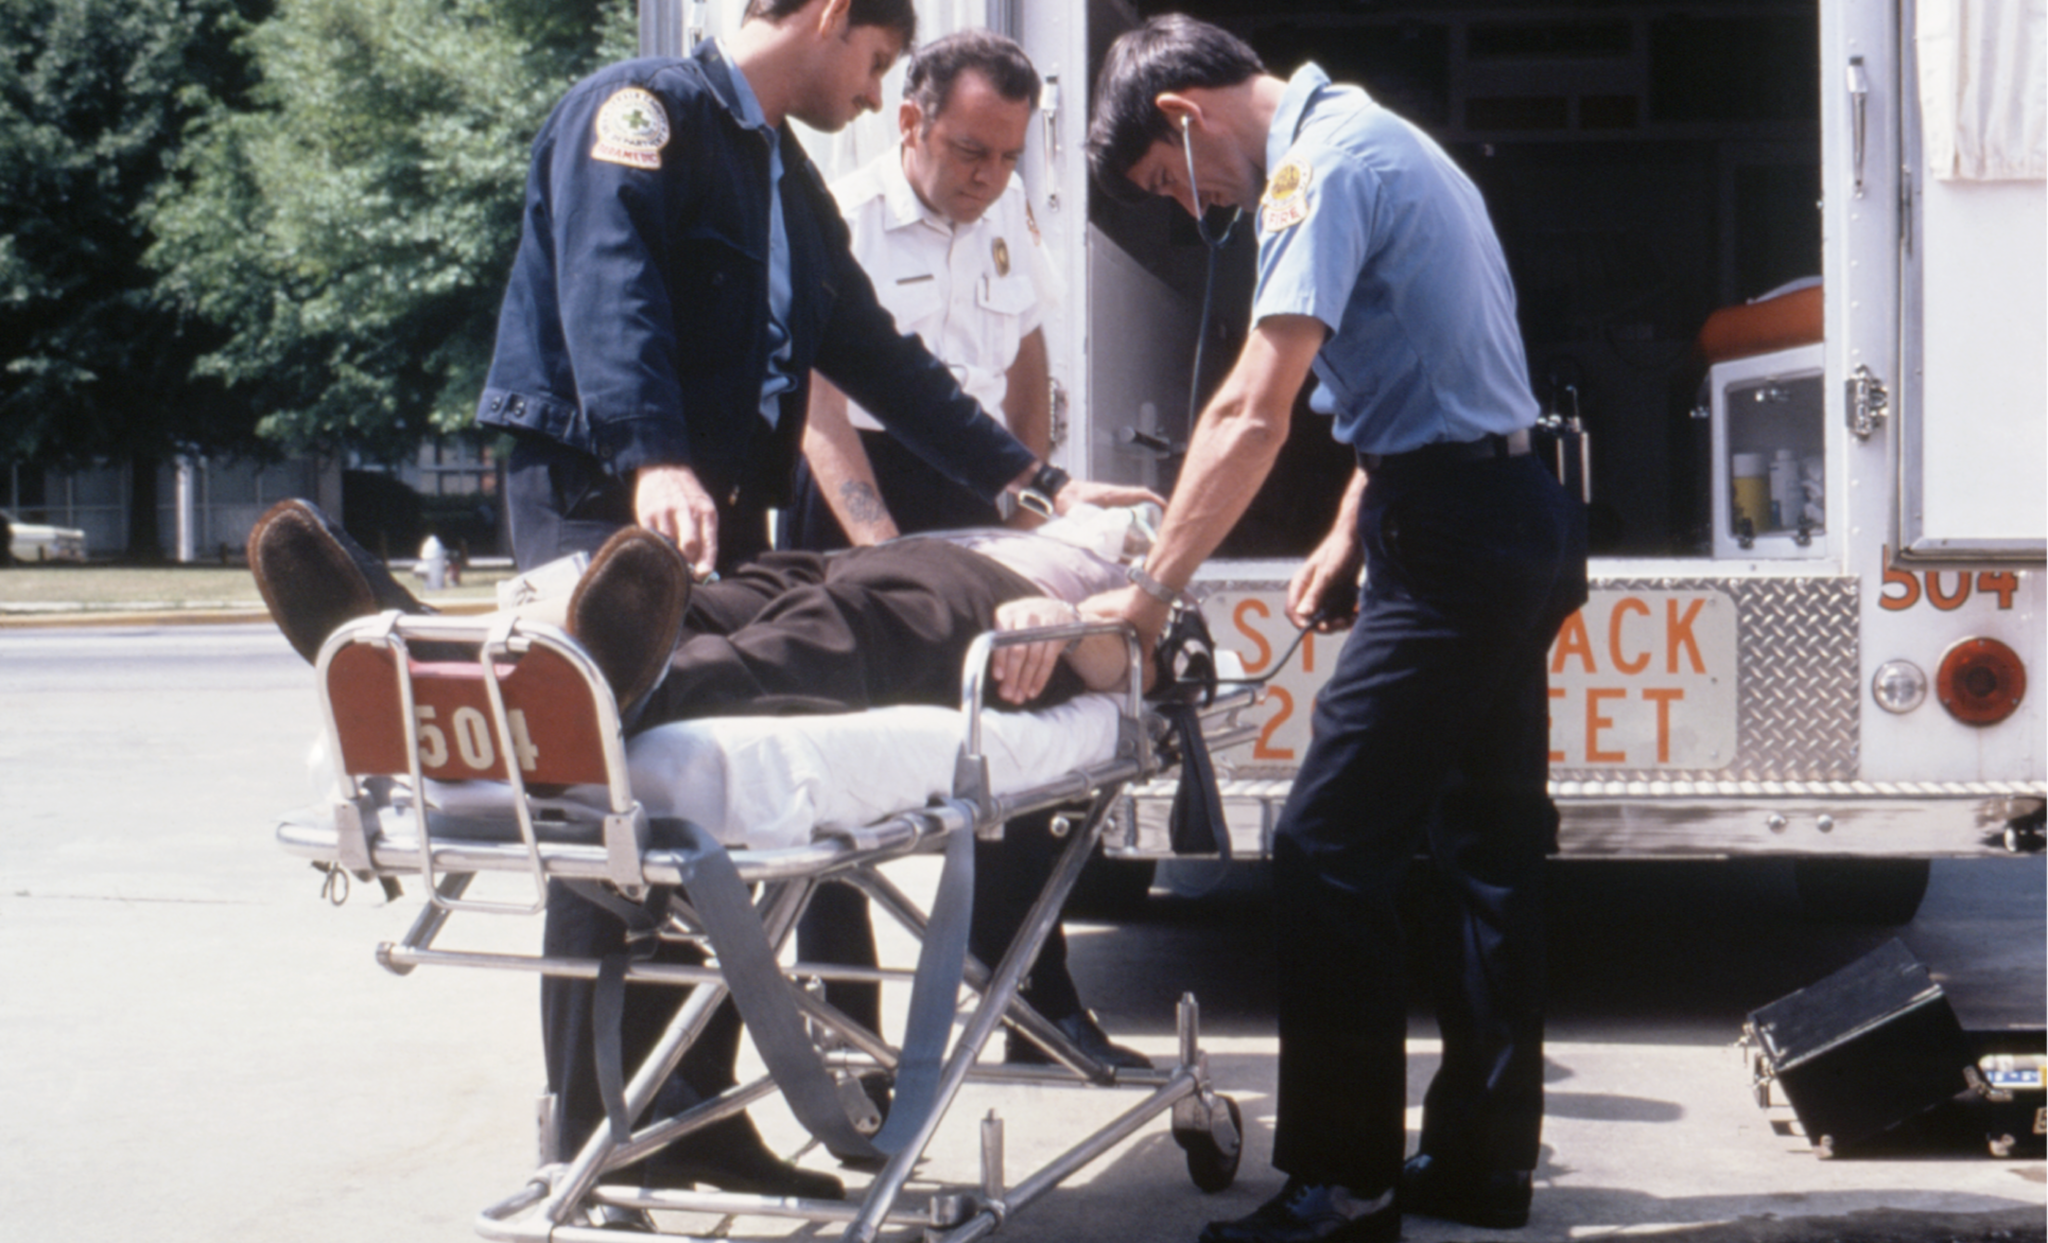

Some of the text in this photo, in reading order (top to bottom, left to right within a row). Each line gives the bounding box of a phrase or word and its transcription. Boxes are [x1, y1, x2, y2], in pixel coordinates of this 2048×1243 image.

[1878, 544, 2018, 611] 504
[1551, 597, 1706, 675] ACK
[415, 705, 539, 771] 504
